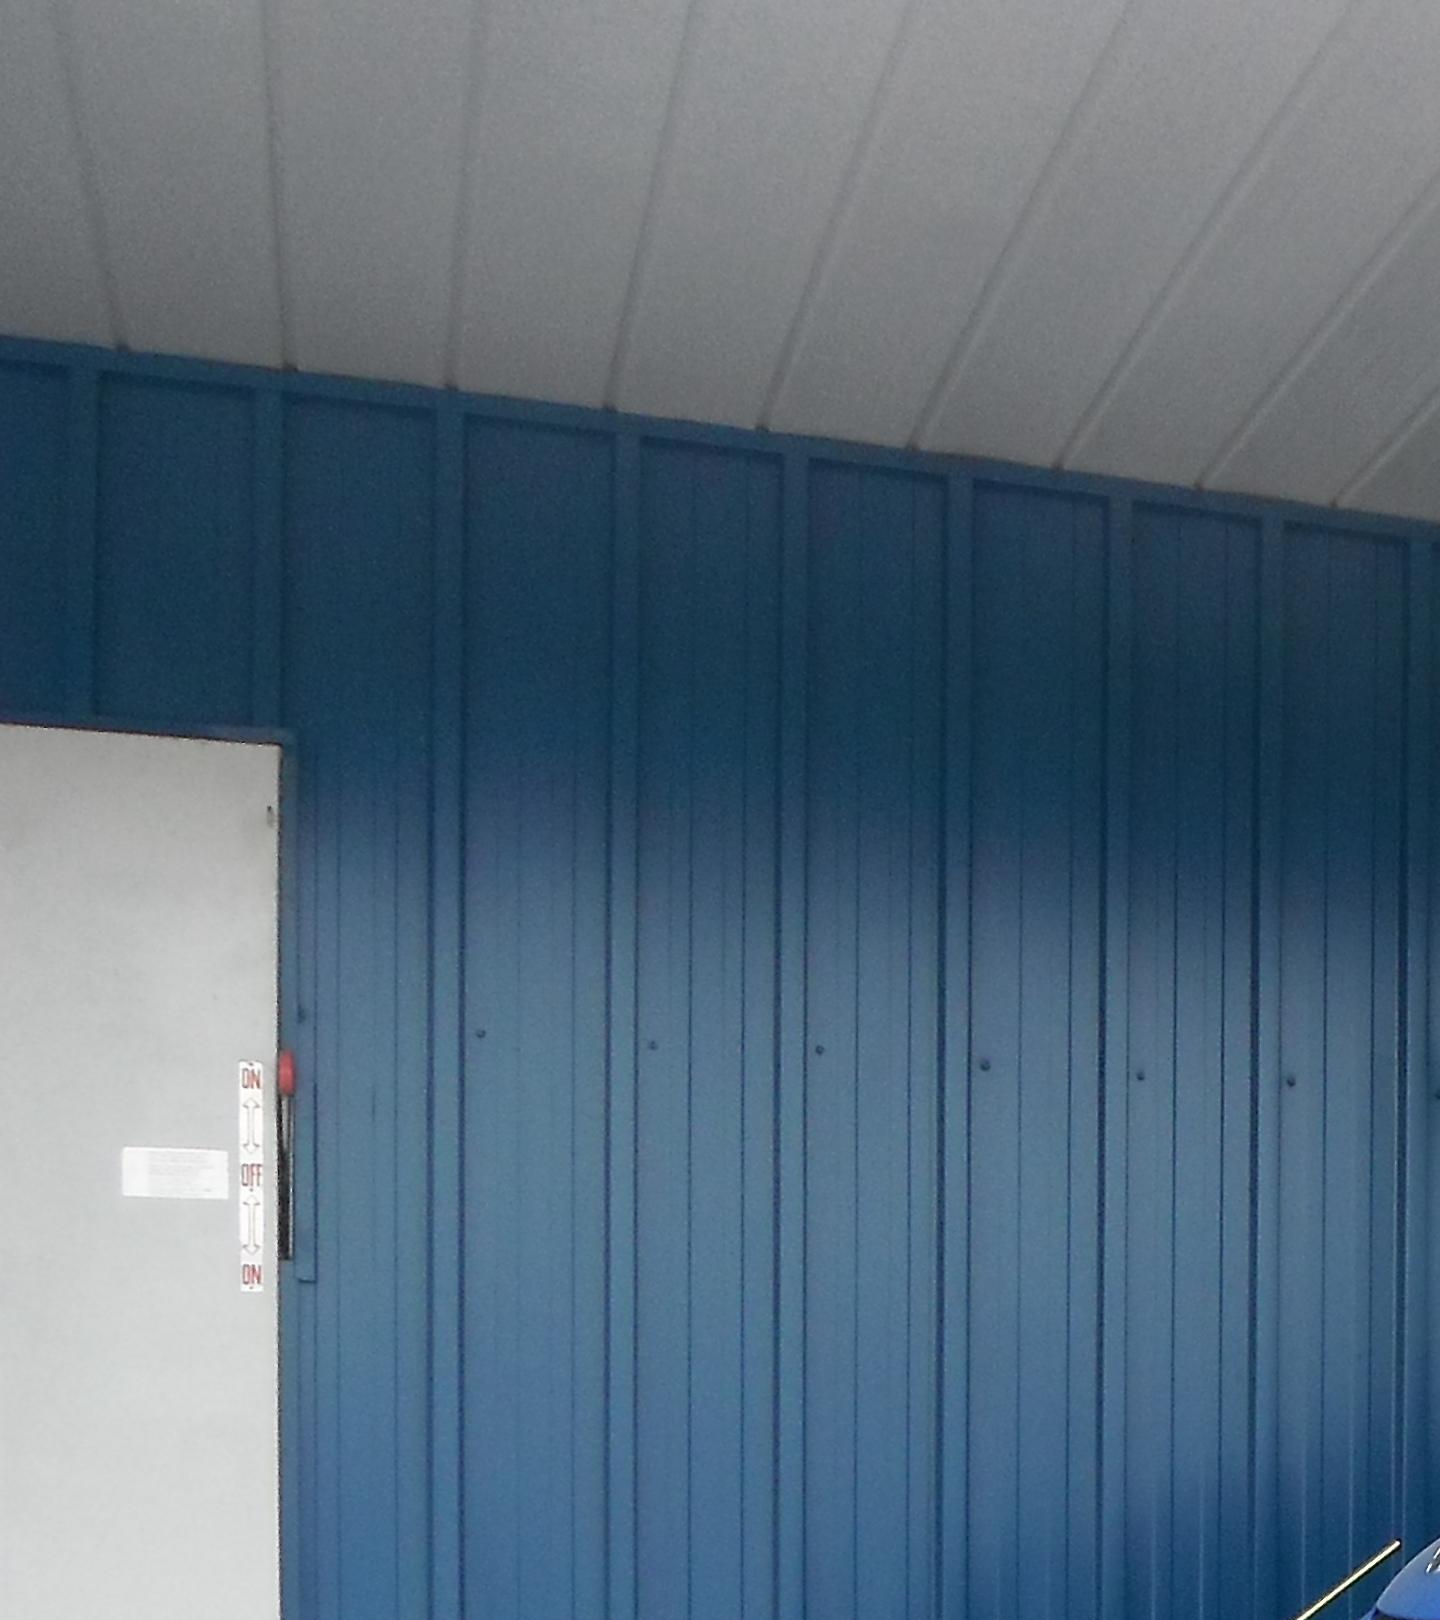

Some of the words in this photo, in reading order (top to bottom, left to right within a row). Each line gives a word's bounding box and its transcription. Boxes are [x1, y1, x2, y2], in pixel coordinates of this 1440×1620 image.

[241, 1068, 261, 1090] ON
[240, 1163, 263, 1187] OFF
[241, 1264, 261, 1286] ON
